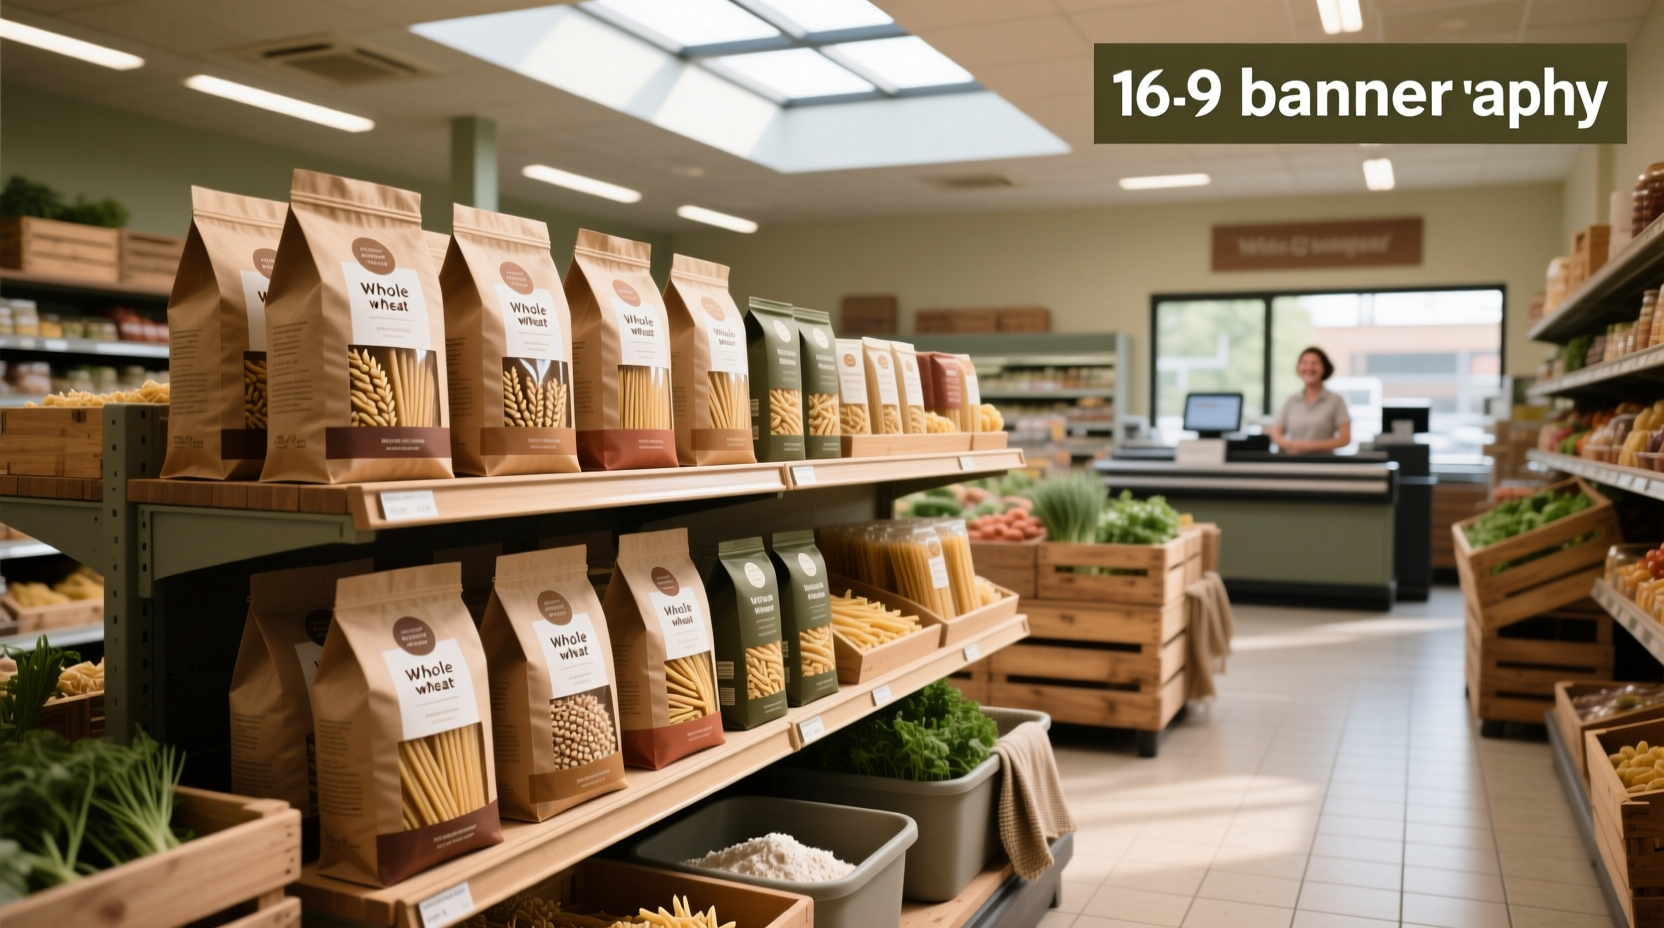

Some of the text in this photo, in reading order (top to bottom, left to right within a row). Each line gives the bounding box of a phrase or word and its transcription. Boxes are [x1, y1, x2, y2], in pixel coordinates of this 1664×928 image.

[360, 281, 409, 298] Whole
[369, 298, 409, 312] wheat
[509, 301, 547, 316] Whole
[549, 630, 587, 649] Whole
[405, 660, 453, 682] Whole
[415, 677, 455, 696] wheat
